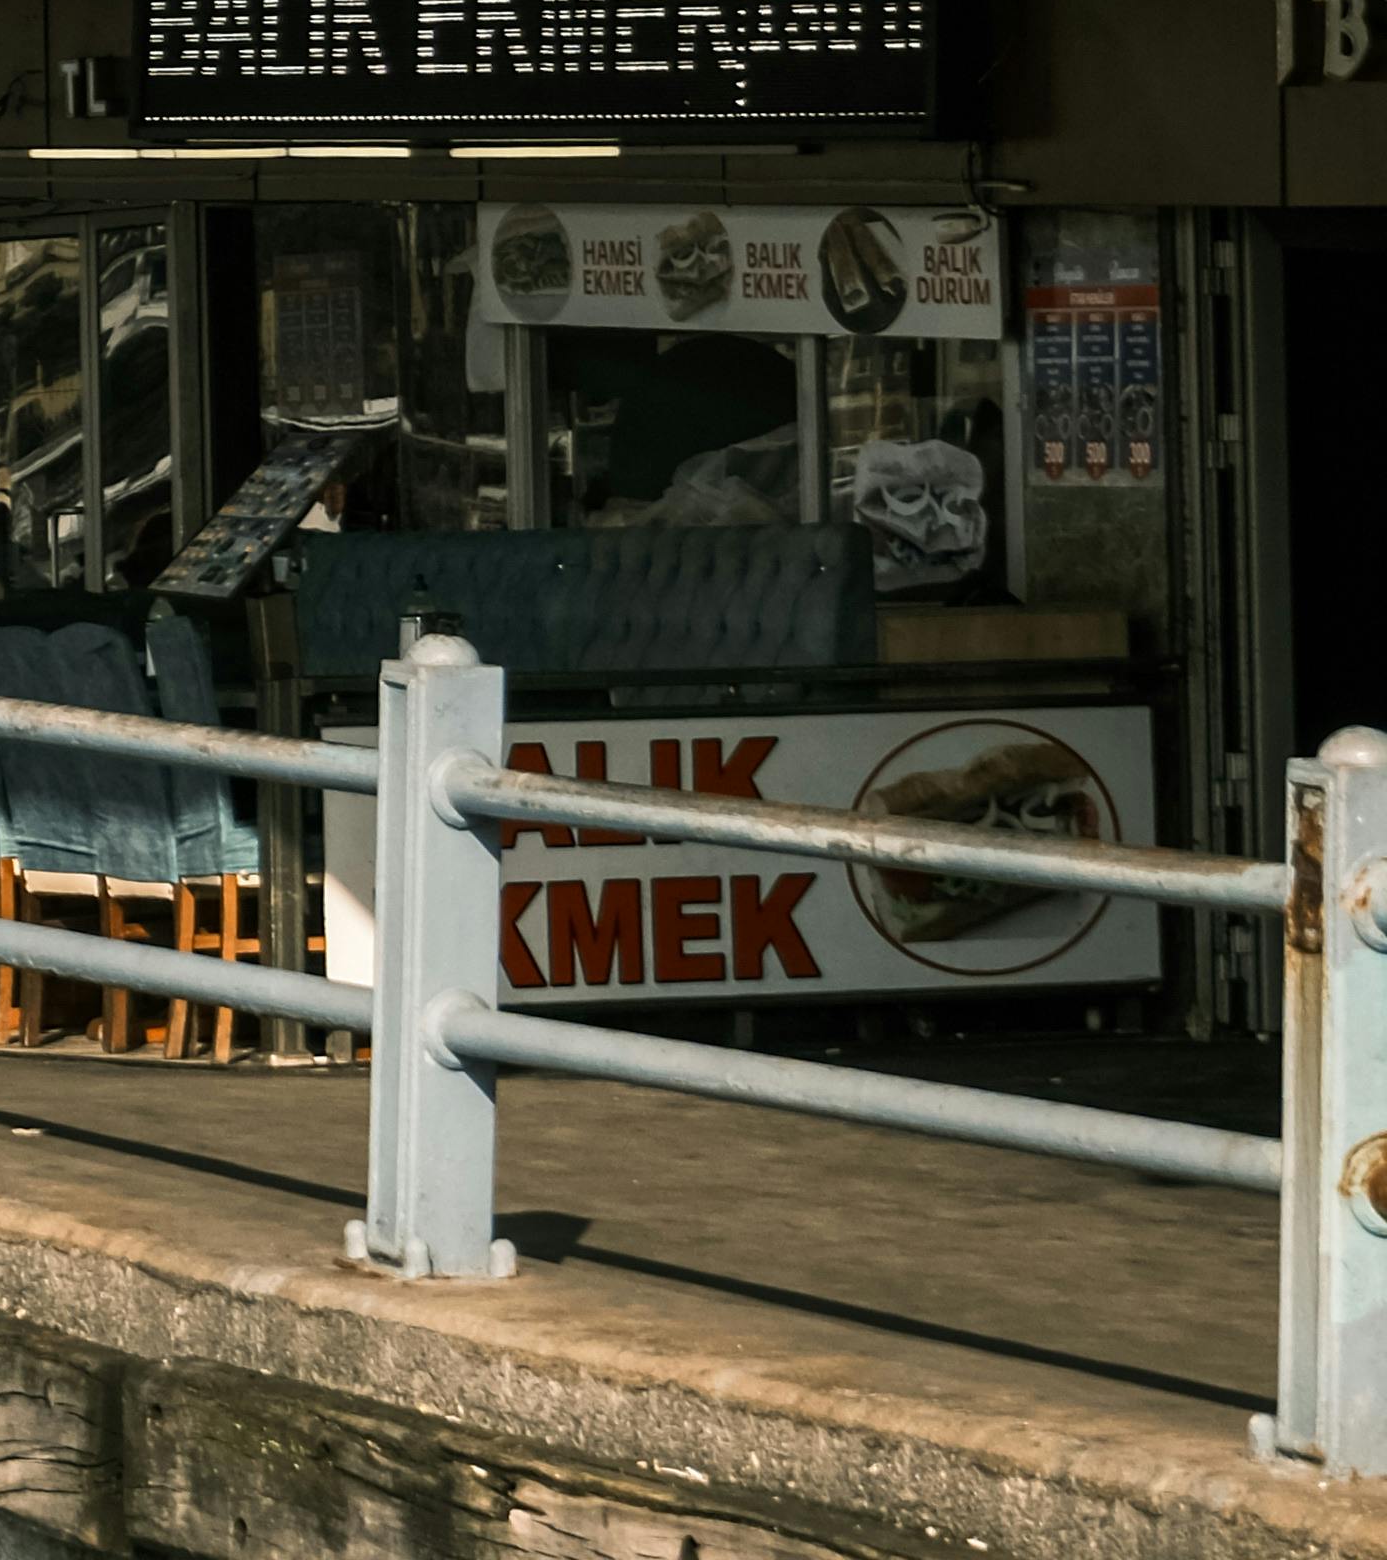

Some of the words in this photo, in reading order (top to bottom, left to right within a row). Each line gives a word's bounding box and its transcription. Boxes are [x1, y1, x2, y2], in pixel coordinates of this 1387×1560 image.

[60, 58, 110, 117] TL
[583, 238, 643, 267] HAMSİ
[746, 242, 803, 270] BALIK
[924, 245, 981, 273] BALIK
[583, 269, 647, 297] EKMEK
[742, 272, 809, 300] EKMEK
[502, 735, 780, 848] ALIK
[499, 872, 823, 988] KMEK
